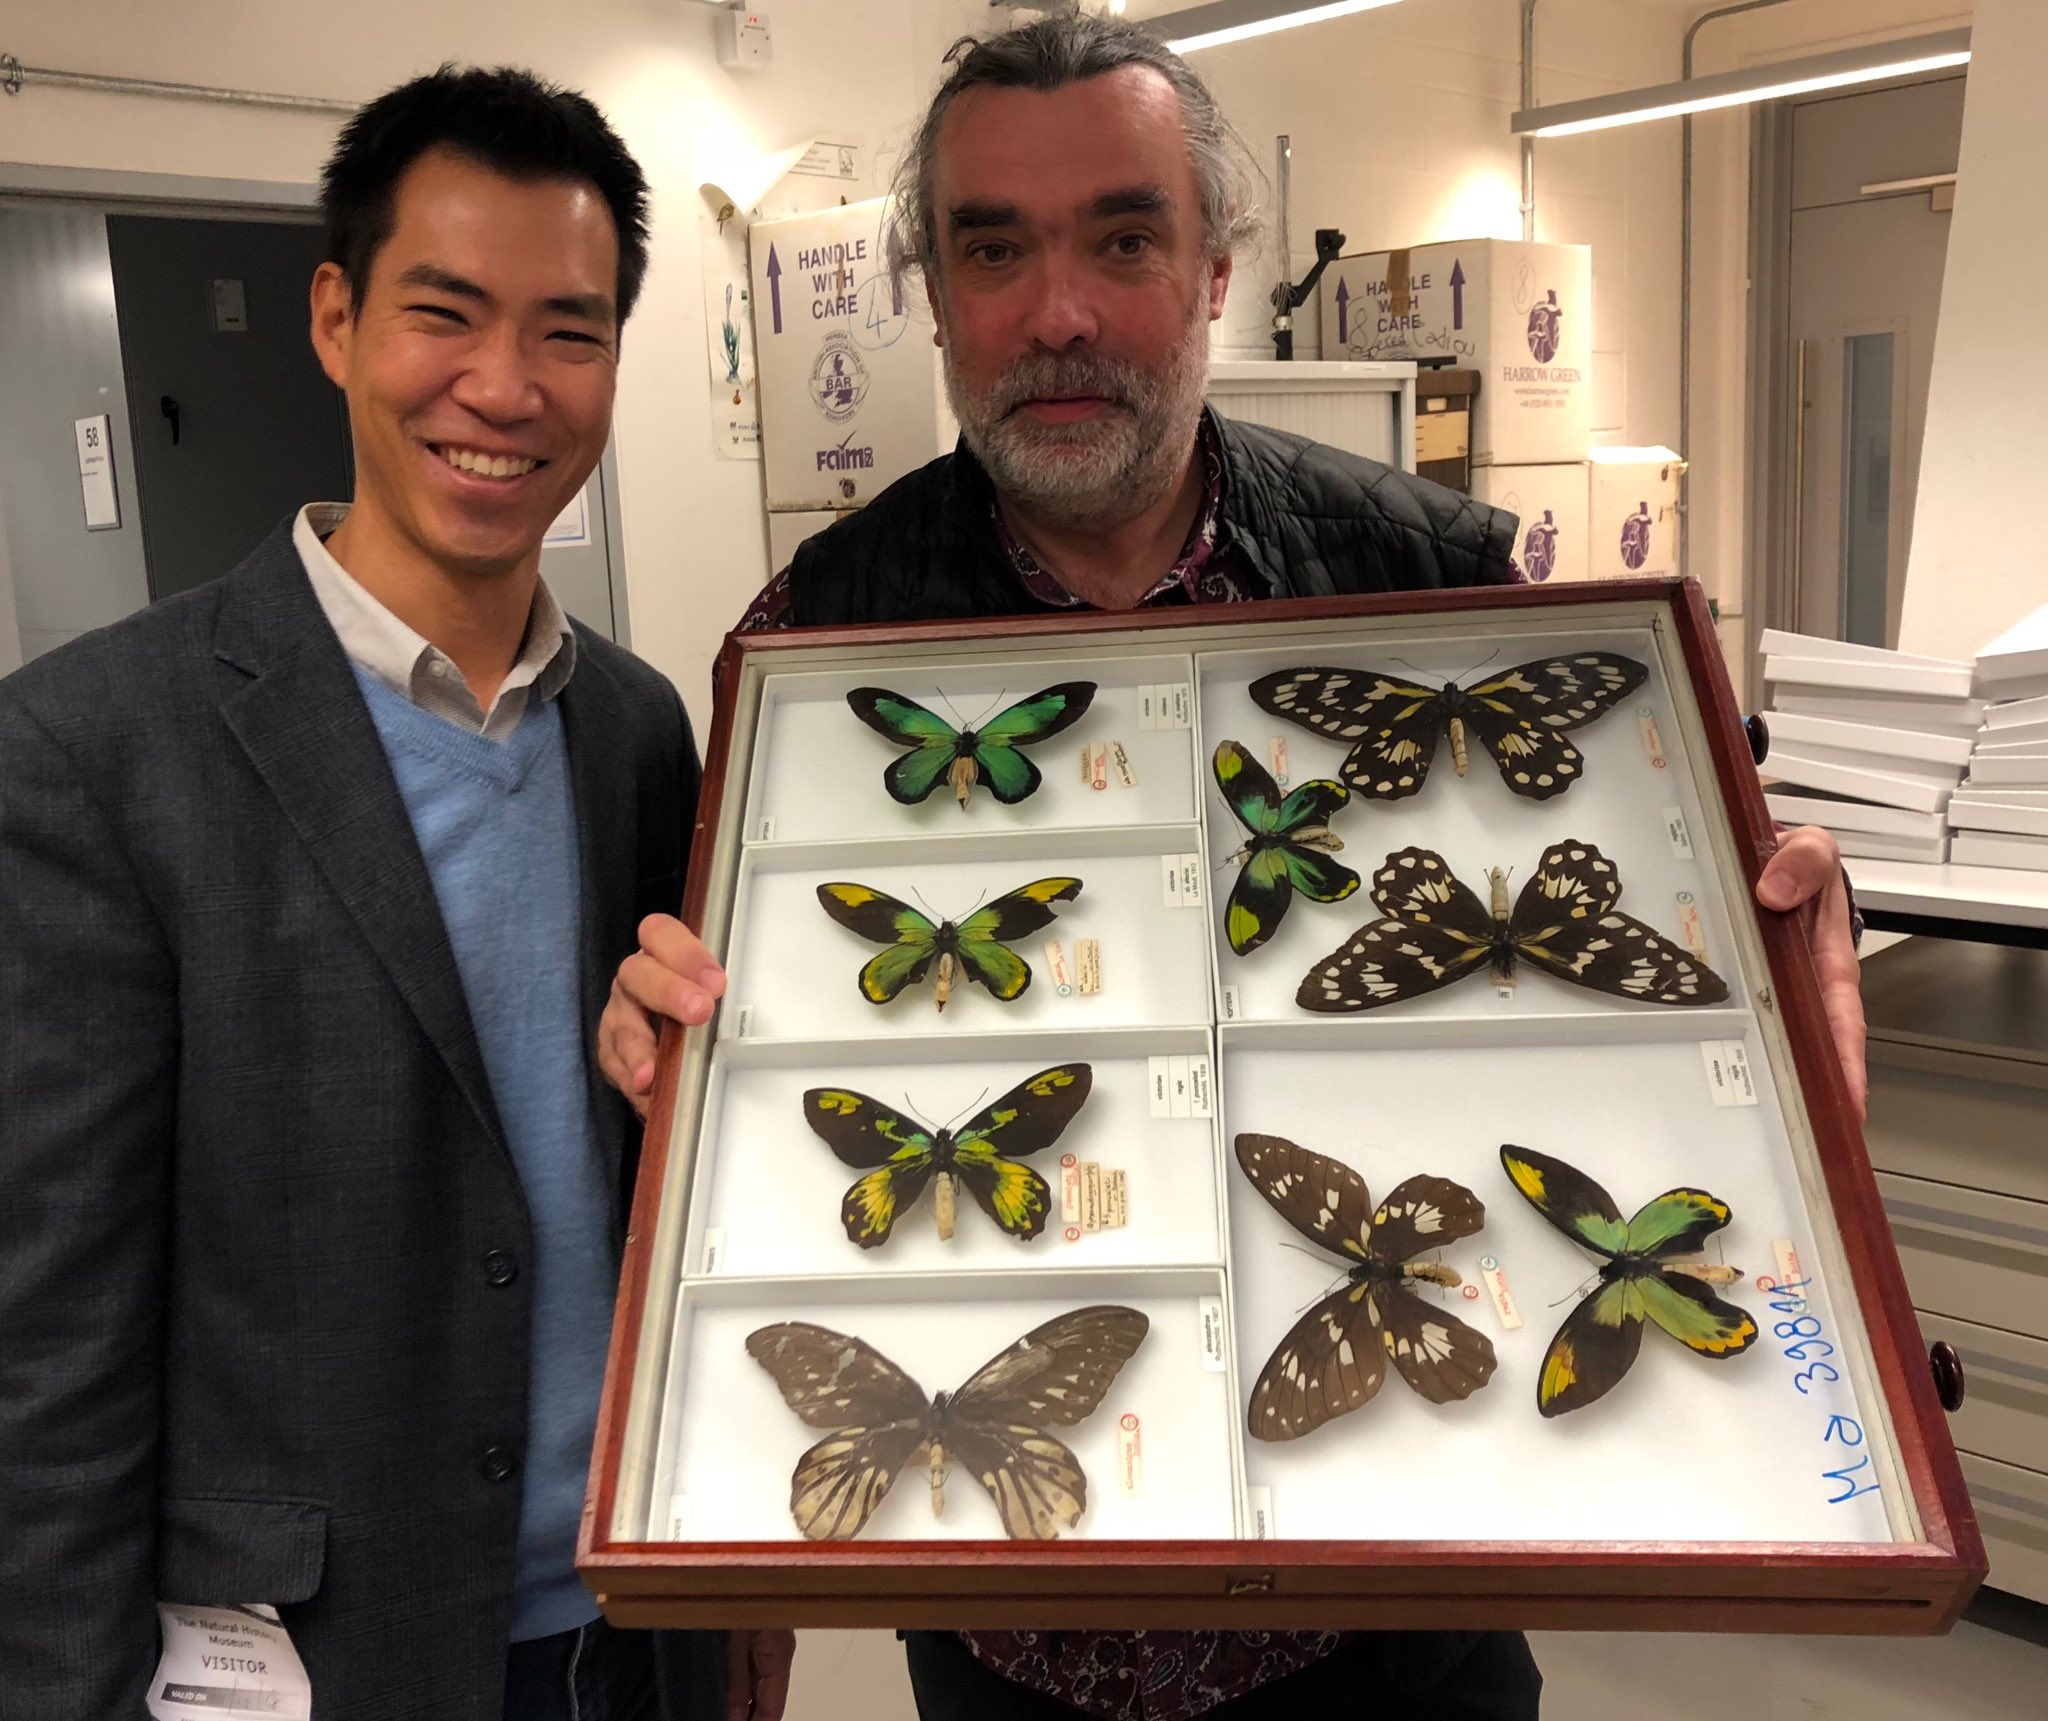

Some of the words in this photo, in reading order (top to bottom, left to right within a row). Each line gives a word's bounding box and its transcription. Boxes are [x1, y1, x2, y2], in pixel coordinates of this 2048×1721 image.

[798, 239, 867, 270] HANDLE
[812, 268, 855, 293] WITH
[1366, 273, 1432, 297] HALE
[1517, 264, 1529, 304] 8
[811, 294, 859, 320] CARE
[866, 279, 889, 339] 4
[1378, 295, 1419, 313] WH
[1377, 314, 1422, 333] CARE
[825, 376, 852, 391] BAR
[1503, 366, 1549, 382] HARROW
[1550, 368, 1582, 382] GREEN
[86, 427, 99, 448] 58
[177, 1616, 196, 1628] The
[199, 1620, 239, 1633] Natural
[209, 1635, 254, 1649] Museum
[201, 1654, 268, 1675] VISITOR
[170, 1689, 195, 1701] VALID
[195, 1692, 208, 1701] ON
